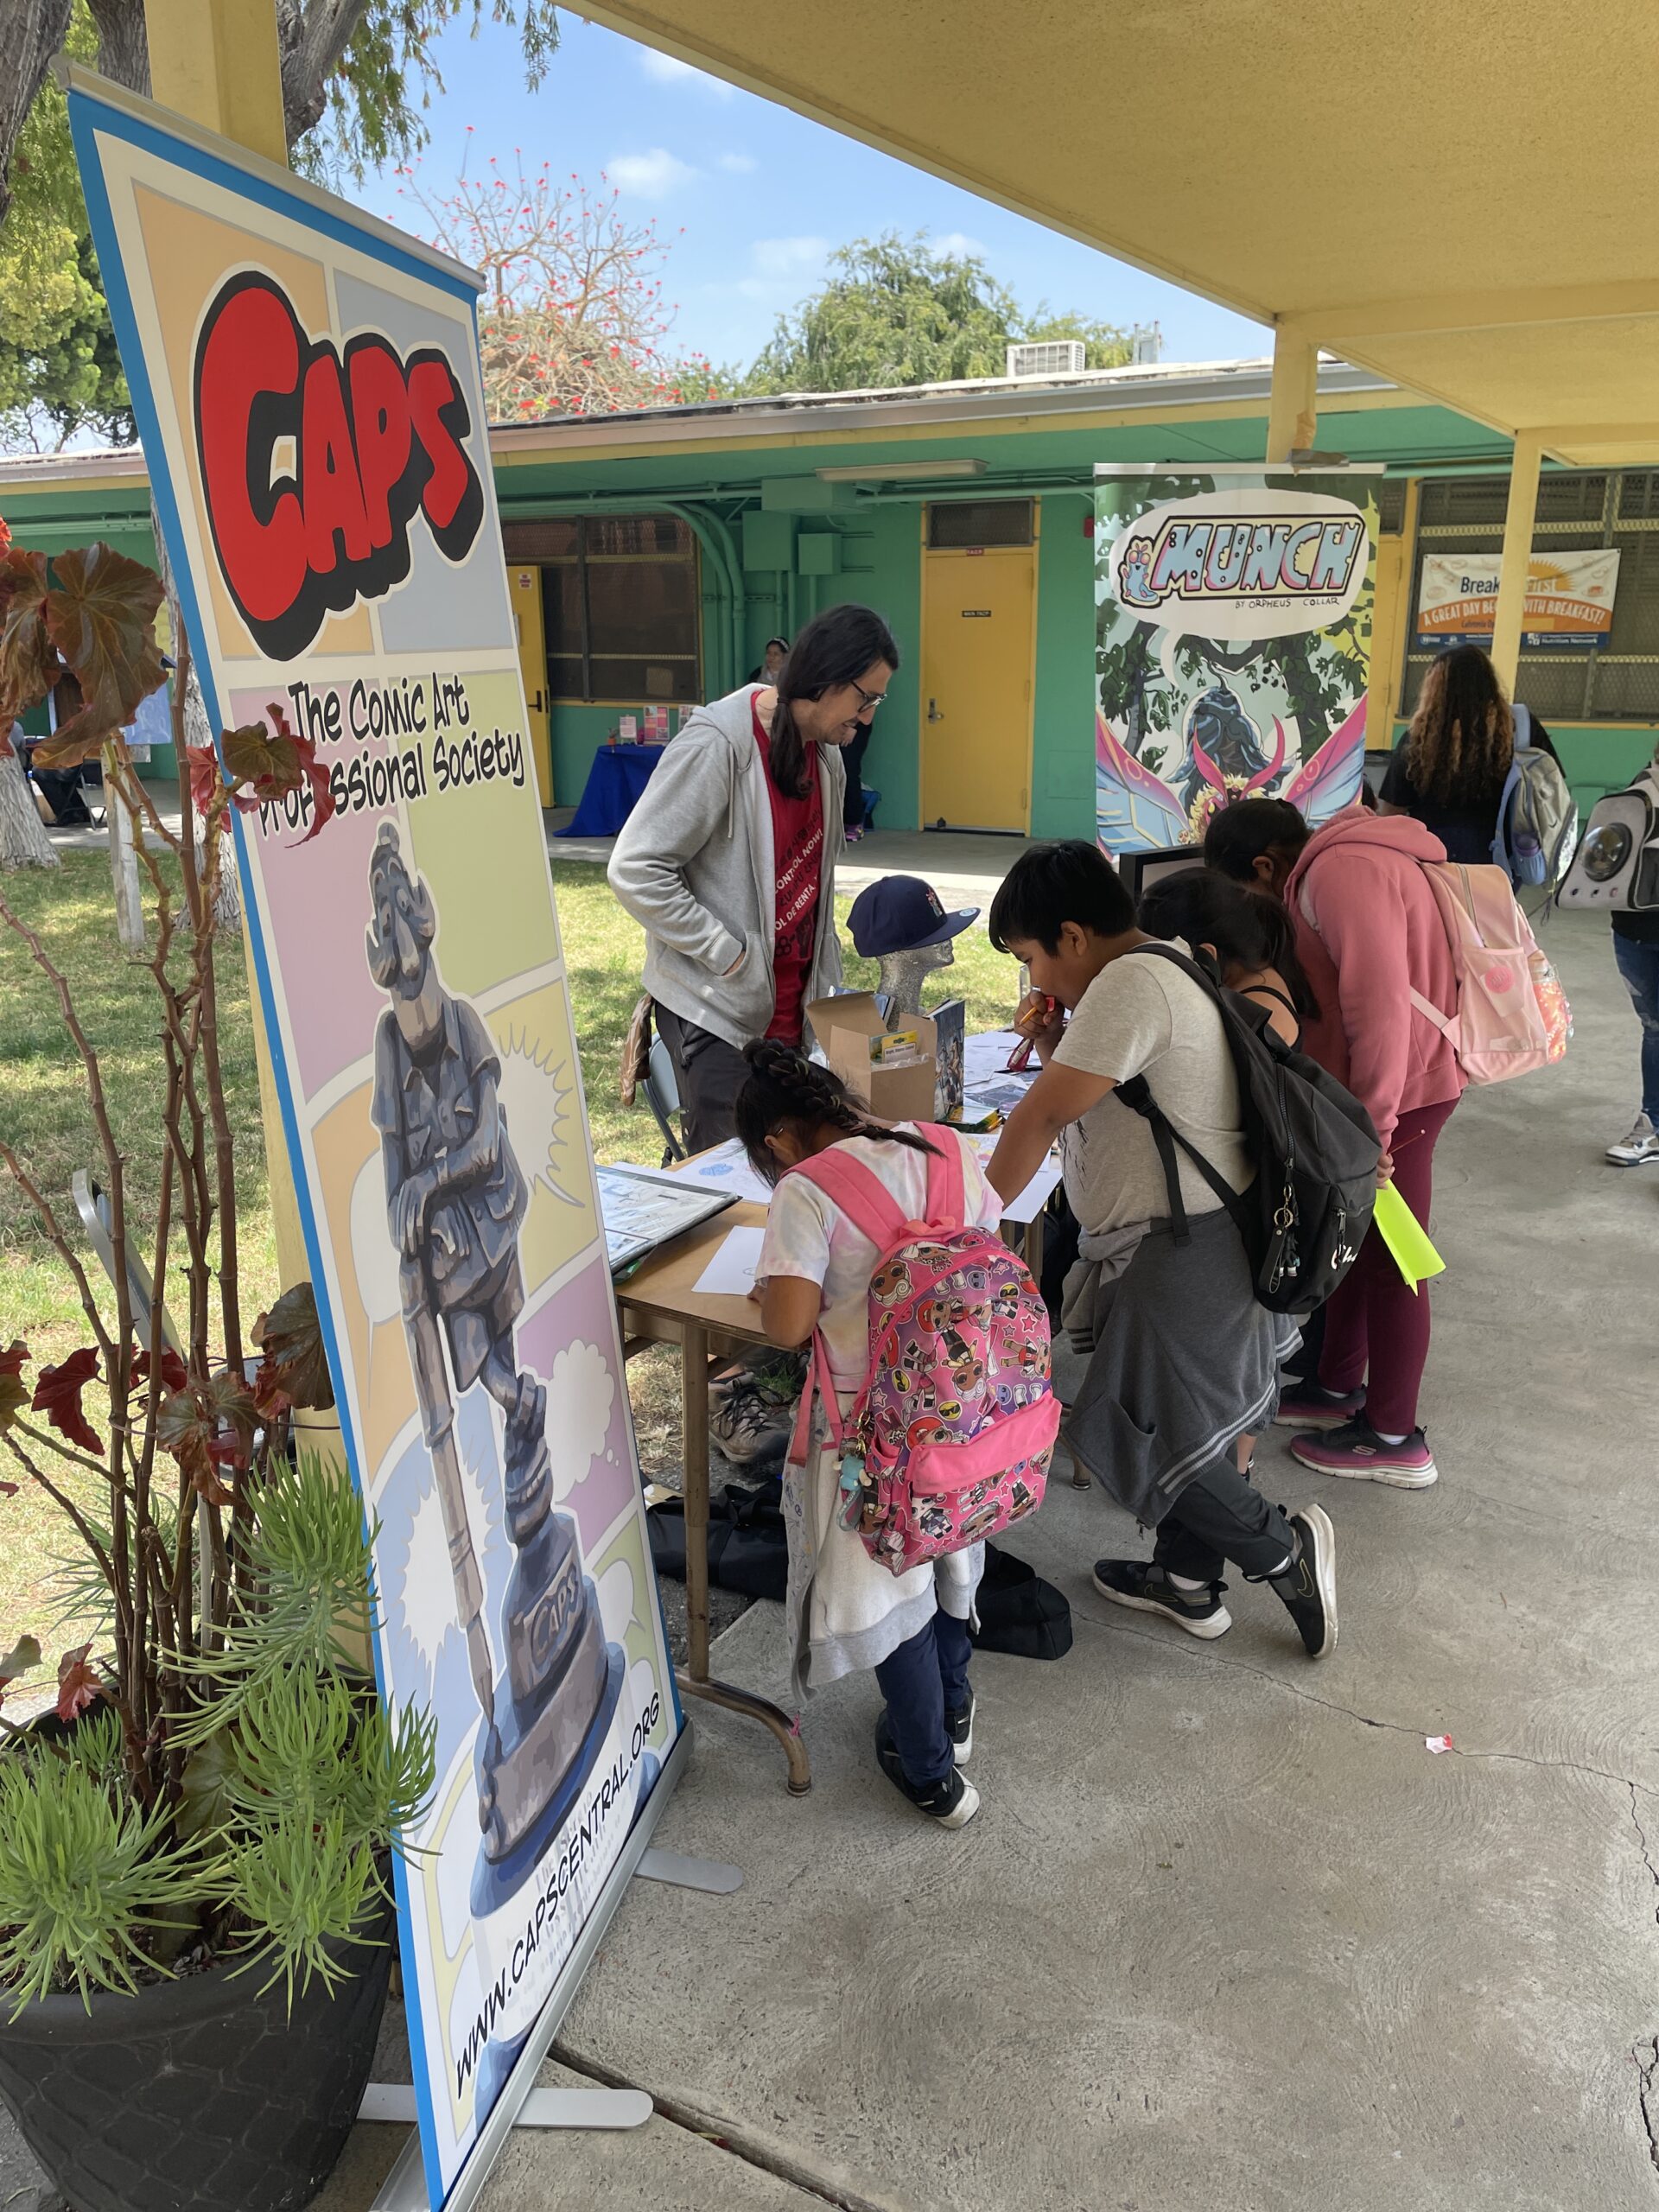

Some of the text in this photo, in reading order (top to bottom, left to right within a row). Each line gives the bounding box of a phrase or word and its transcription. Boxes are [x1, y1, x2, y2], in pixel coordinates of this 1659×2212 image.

[194, 271, 483, 661] CAPS
[1149, 521, 1361, 592] MUNCH
[1460, 576, 1501, 594] Break
[1235, 597, 1339, 609] BY ORPHEUS COLLAR
[1424, 613, 1431, 627] A
[1432, 603, 1461, 623] GREAT
[1463, 601, 1480, 617] DAY
[1547, 600, 1605, 626] BREAKFAST!
[288, 672, 469, 742] The Comic Art
[260, 728, 524, 837] Profssional Society
[774, 855, 803, 894] ONTOL
[802, 828, 823, 858] NOW!
[786, 907, 797, 922] DE
[795, 883, 816, 911] RENTA
[456, 1691, 660, 2101] WWW.CAPSCENTRAL.ORG
